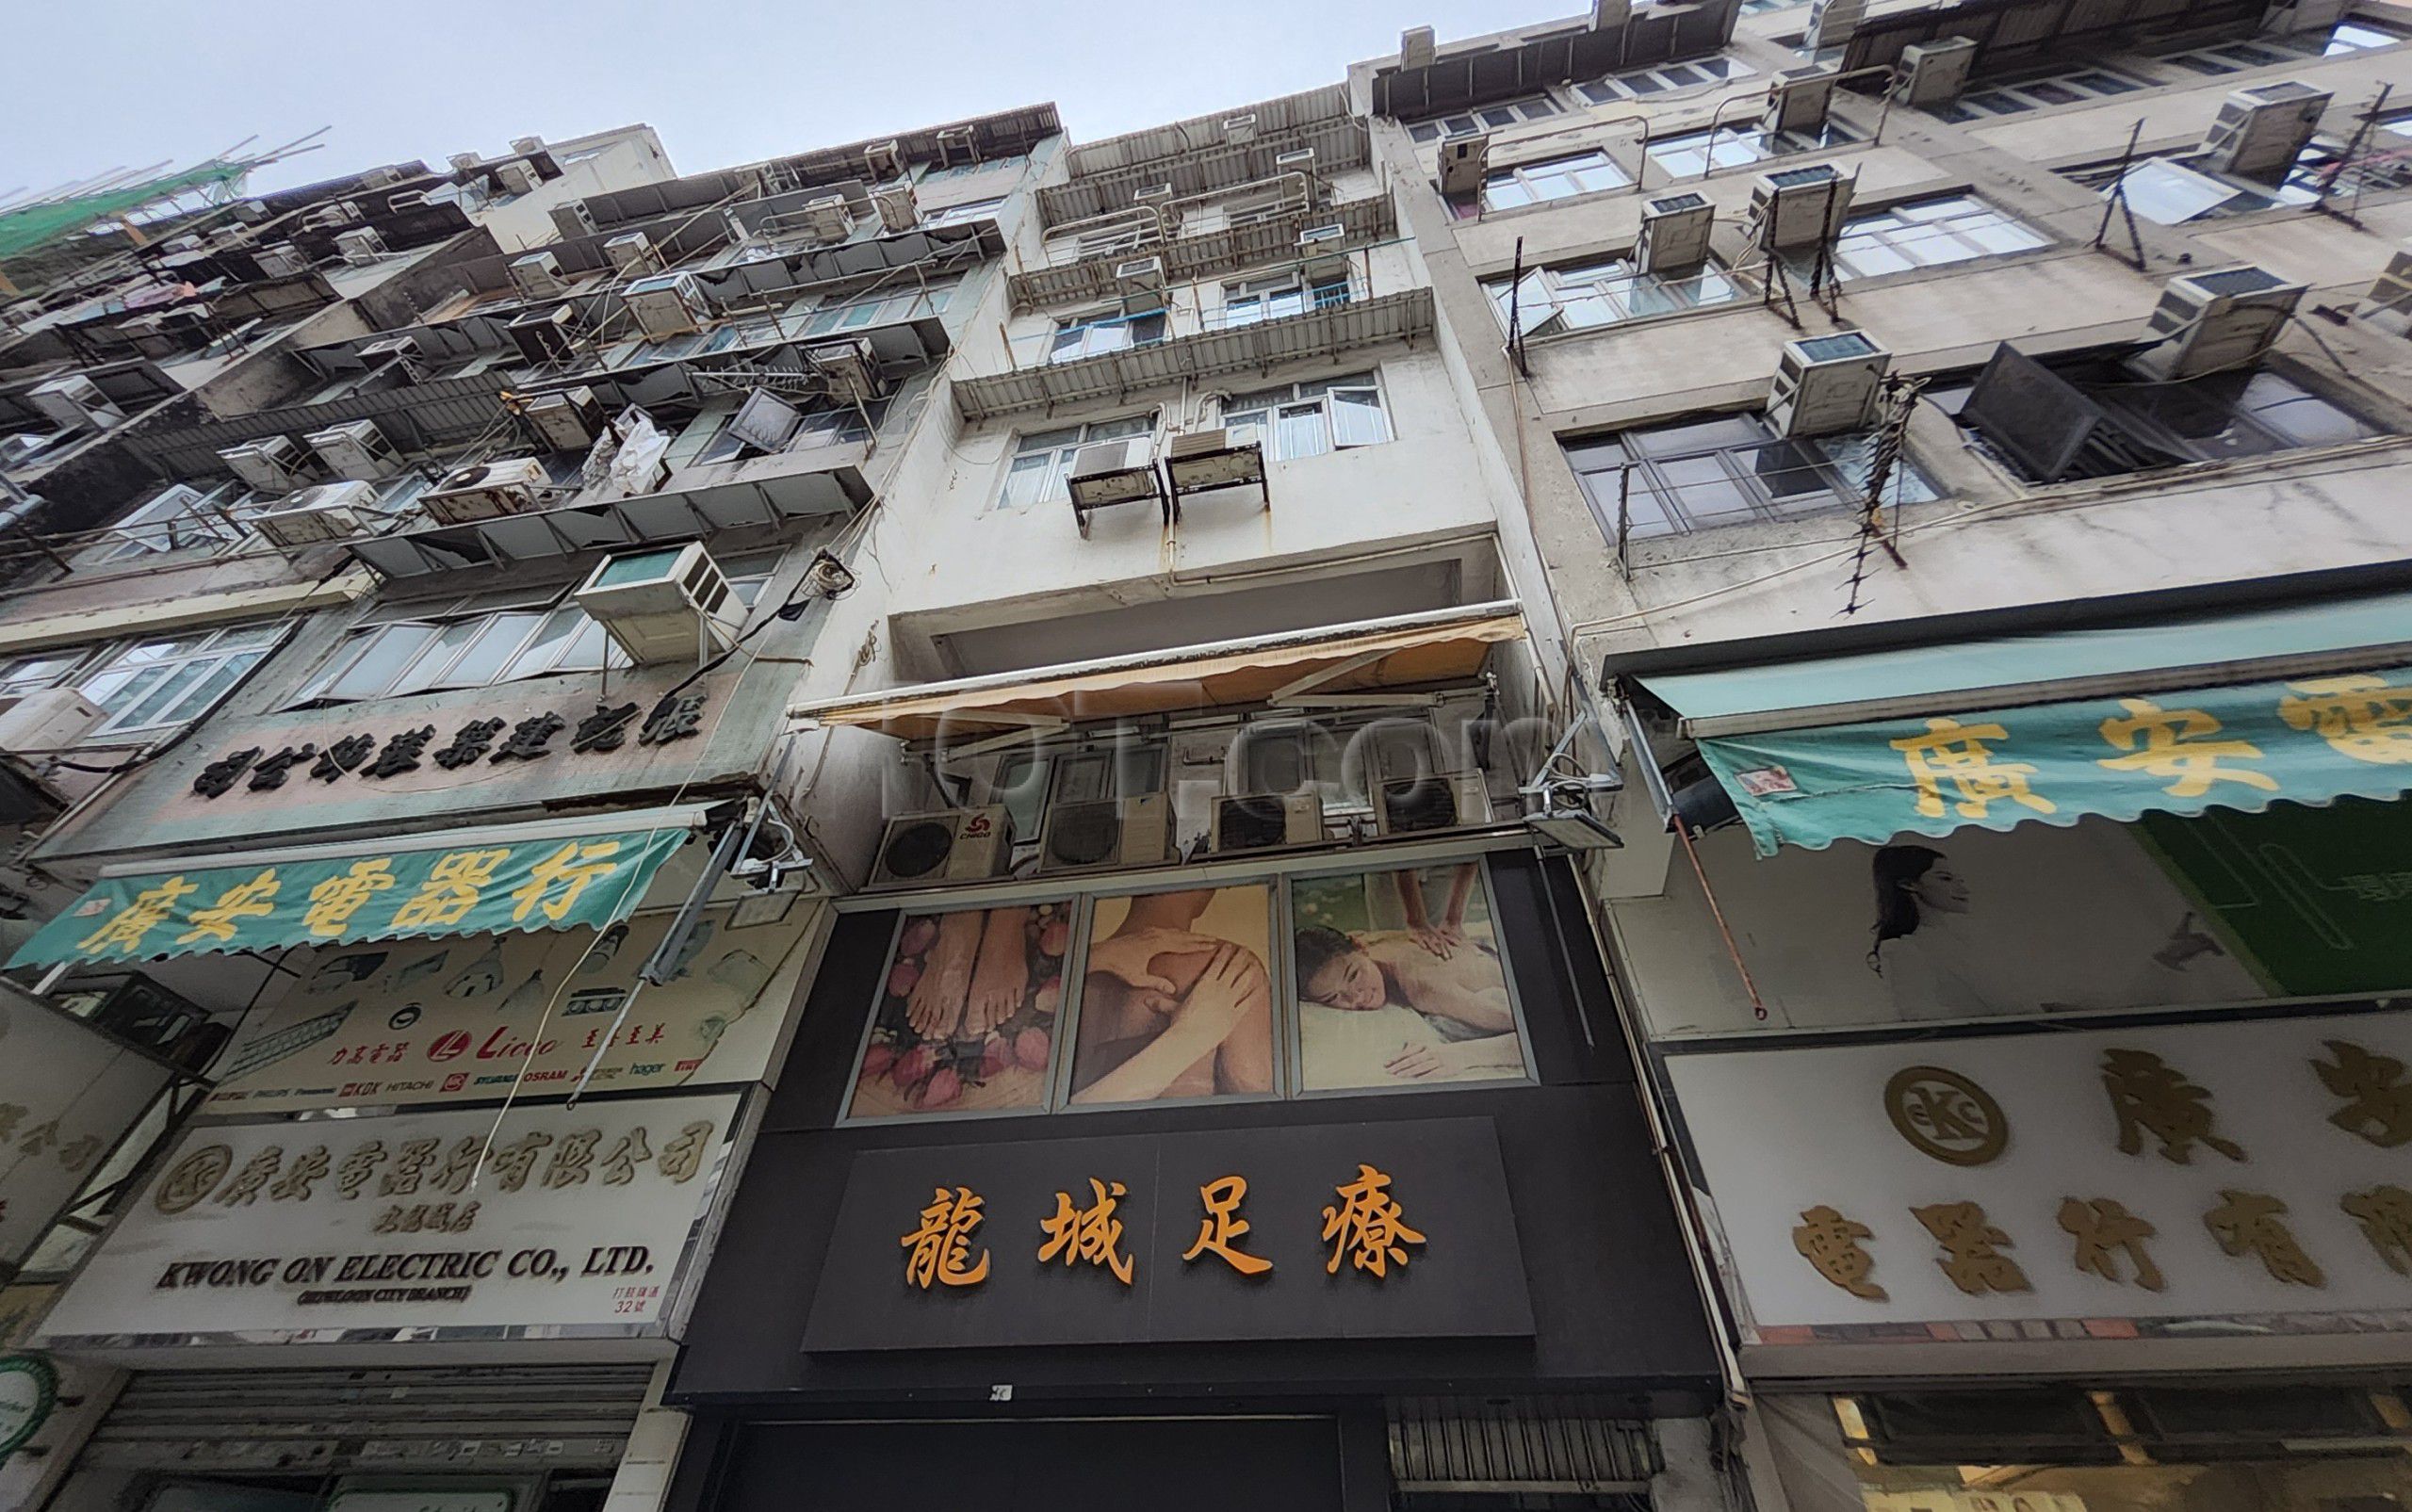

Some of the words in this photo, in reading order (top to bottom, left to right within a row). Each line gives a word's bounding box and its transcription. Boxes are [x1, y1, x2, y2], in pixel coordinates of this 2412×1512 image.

[1891, 675, 2412, 818] 廣安電
[79, 841, 622, 953] 廣安電器行
[385, 1081, 434, 1092] HITACHI
[523, 1070, 568, 1082] OSRAM
[629, 1063, 666, 1076] hager
[214, 1120, 713, 1206] 廣安電器行有限公司
[155, 1258, 281, 1290] KWONG
[283, 1256, 336, 1285] ON
[334, 1250, 502, 1282] ELECTRIC
[507, 1248, 570, 1283] CO.,
[580, 1245, 655, 1278] LTD.
[900, 1163, 1426, 1289] 龍城足療
